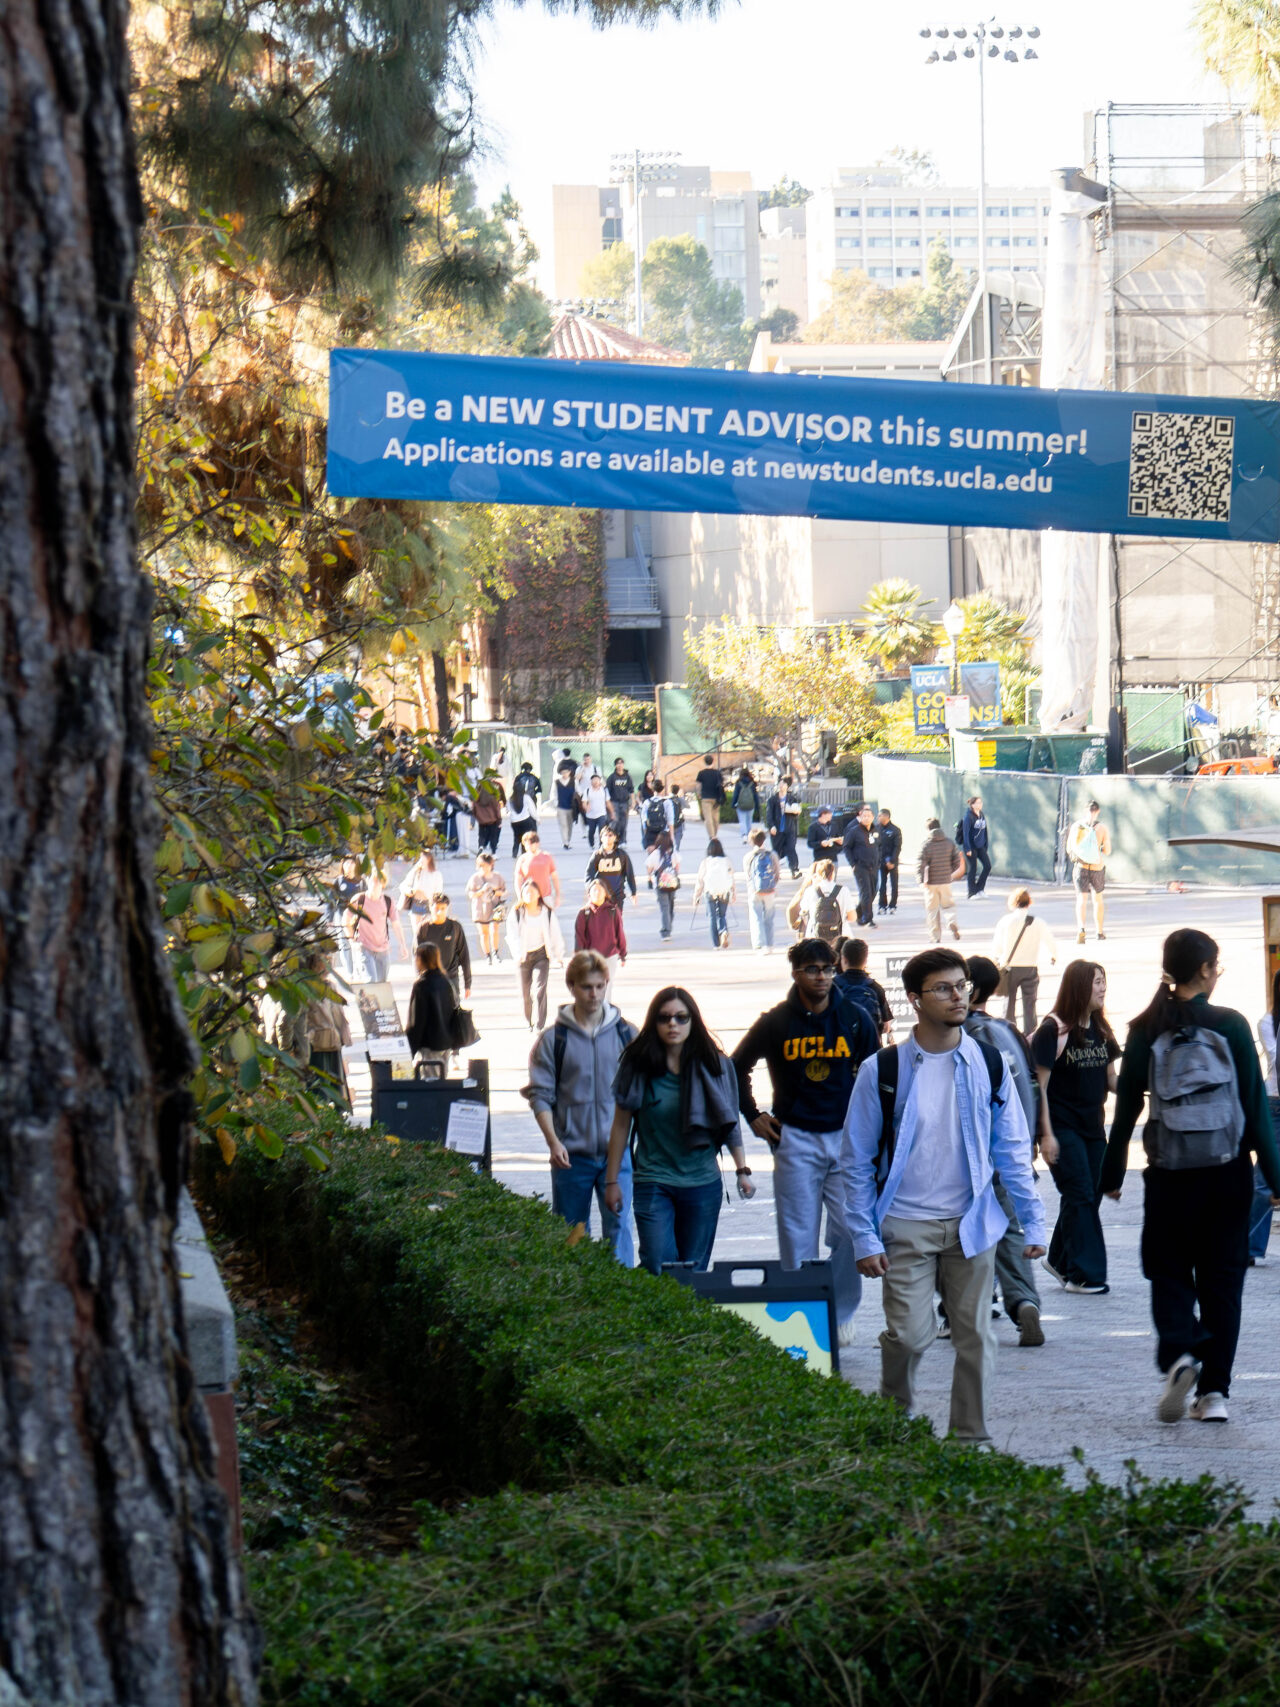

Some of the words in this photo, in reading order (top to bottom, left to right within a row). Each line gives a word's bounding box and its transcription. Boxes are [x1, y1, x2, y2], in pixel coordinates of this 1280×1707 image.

[386, 391, 425, 420] Be
[435, 400, 452, 420] a
[463, 396, 545, 426] NEW
[553, 400, 712, 434] STUDENT
[719, 410, 872, 443] ADVISOR
[880, 416, 940, 447] this
[950, 428, 1087, 456] summer!
[383, 438, 553, 468] Applications
[560, 451, 601, 470] are
[608, 449, 724, 476] available
[732, 456, 757, 478] at
[765, 460, 1052, 493] newstudents.ucla.edu
[916, 675, 946, 687] UCLA
[916, 692, 945, 709] GO
[783, 1036, 851, 1061] UCLA
